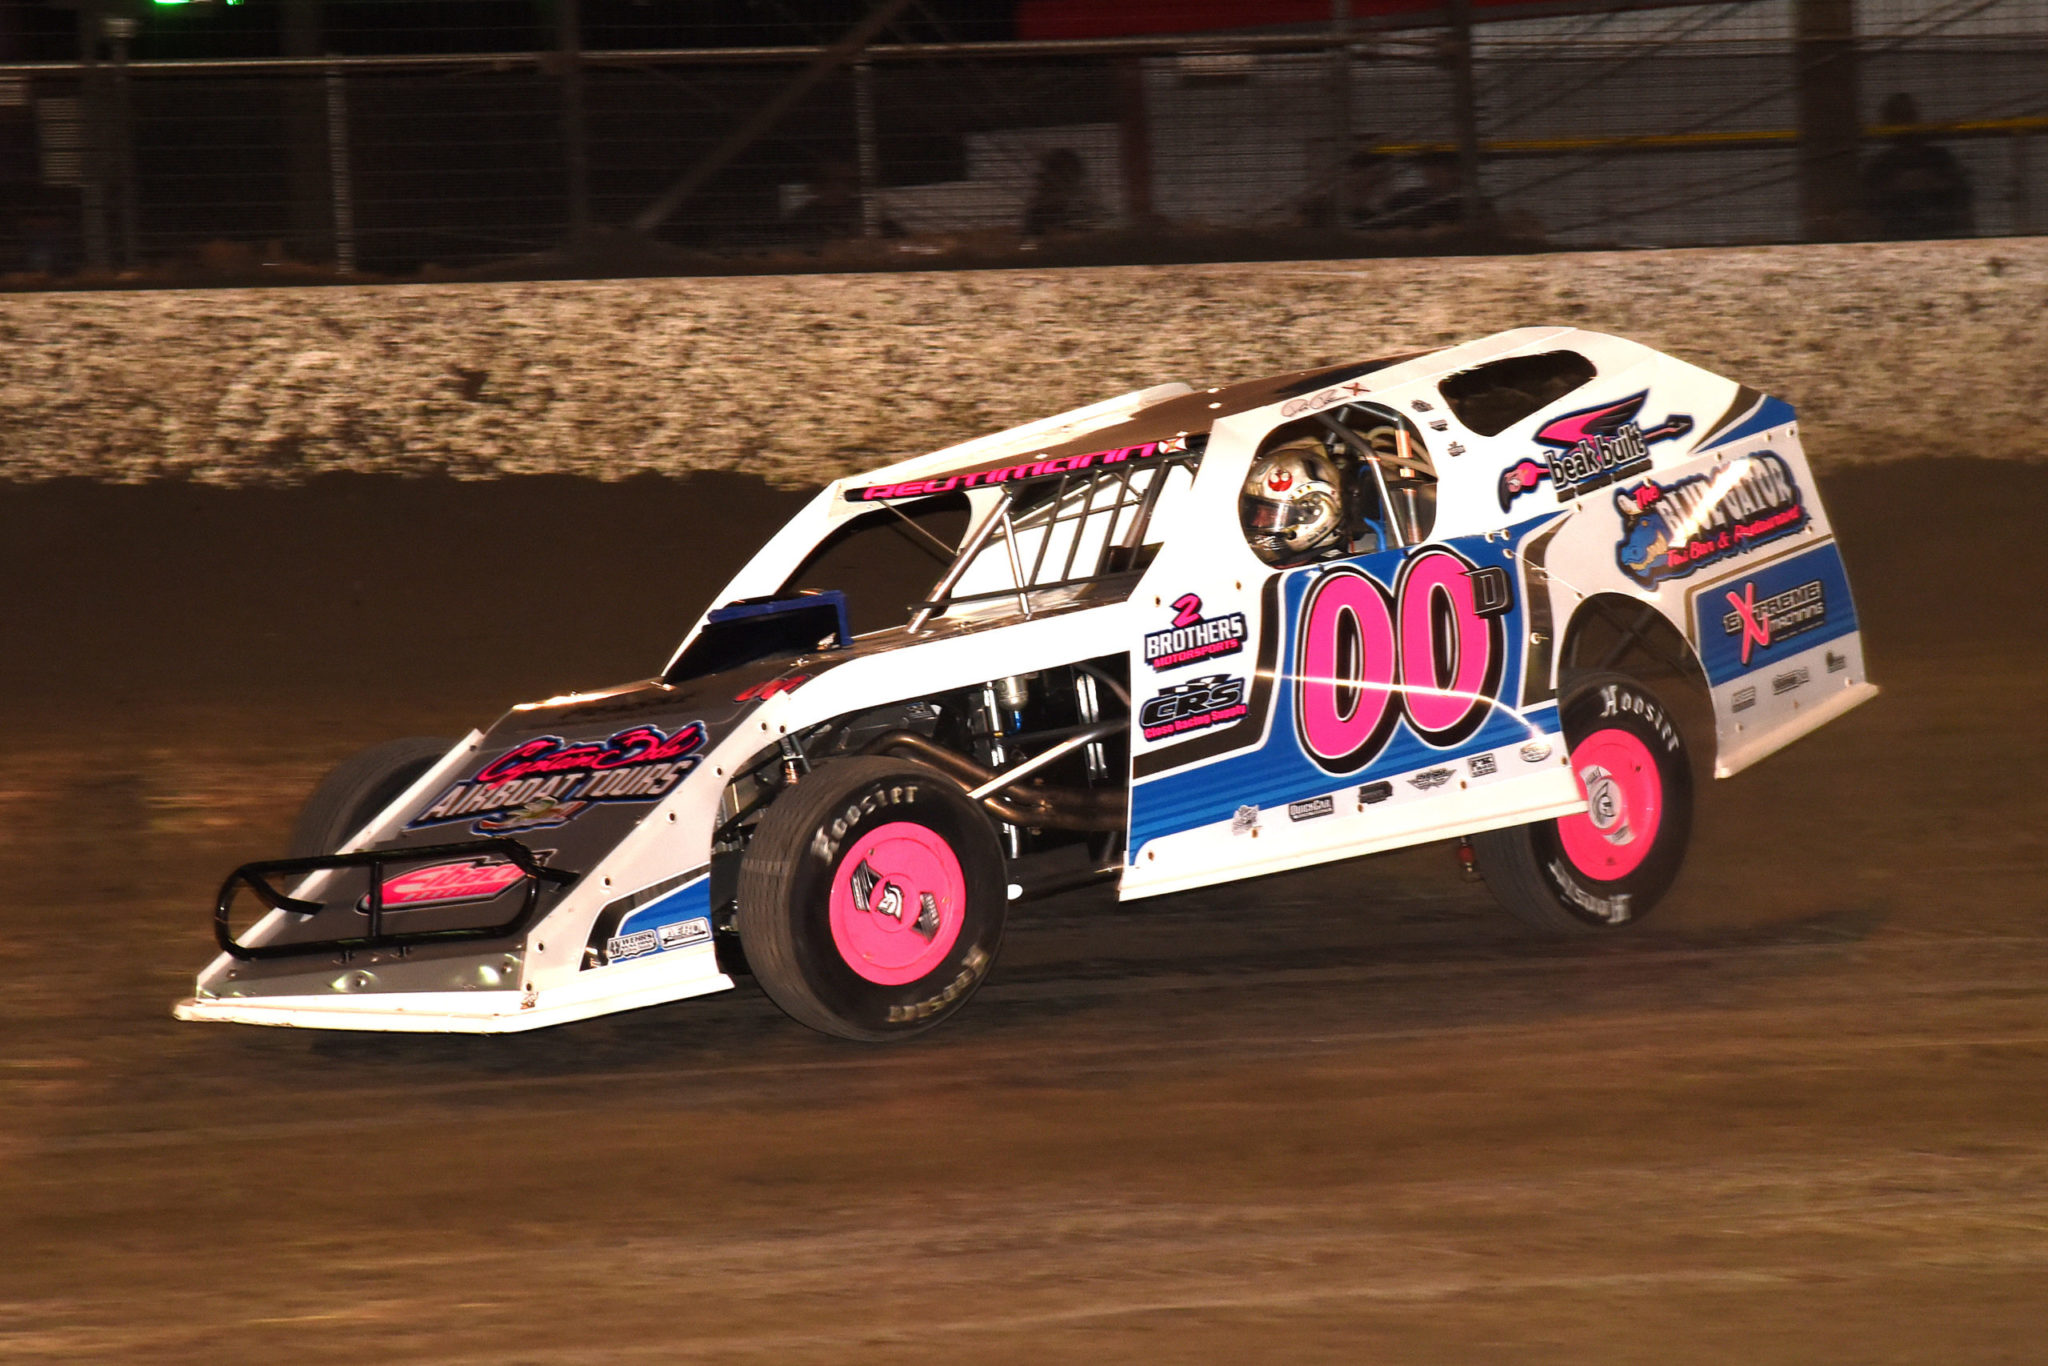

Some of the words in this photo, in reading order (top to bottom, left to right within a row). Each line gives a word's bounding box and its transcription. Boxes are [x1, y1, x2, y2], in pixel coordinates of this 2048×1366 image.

[1544, 439, 1602, 488] beak
[1594, 422, 1648, 470] built
[1717, 531, 1731, 548] &
[1170, 592, 1204, 629] 2
[1723, 582, 1822, 665] EXTREME
[1146, 615, 1244, 660] BROTHERS
[1152, 637, 1240, 669] MOTORSPORTS
[1140, 680, 1243, 727] CRS
[1174, 714, 1212, 732] Racing
[1210, 704, 1247, 722] Supply
[419, 772, 583, 822] AIRBOAT
[574, 760, 690, 799] TOURS
